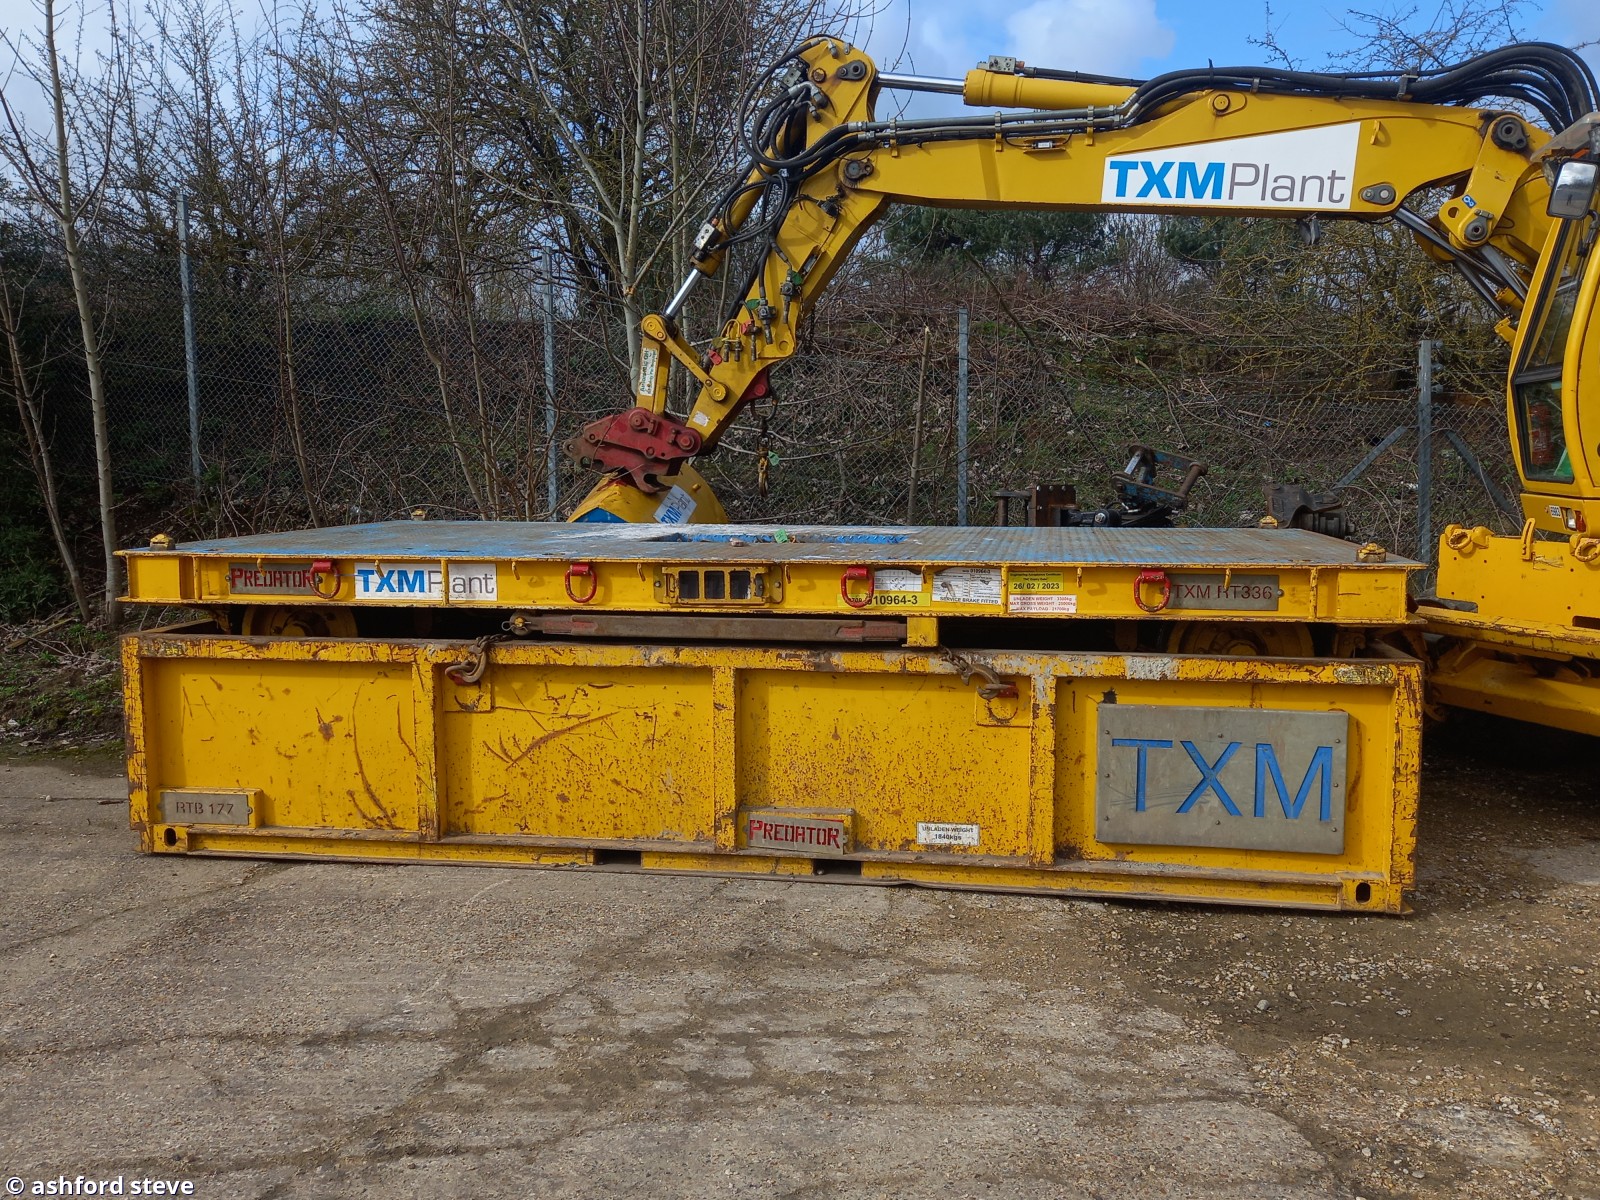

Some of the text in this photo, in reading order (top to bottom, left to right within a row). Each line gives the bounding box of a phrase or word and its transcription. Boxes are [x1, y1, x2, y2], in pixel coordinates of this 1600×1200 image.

[1109, 160, 1346, 204] TXMPlant
[231, 568, 312, 589] PREDATOR
[357, 569, 495, 595] TXMPant
[1172, 584, 1273, 600] TXM RT336
[1111, 738, 1333, 822] TXM
[175, 801, 234, 815] RTB 177
[749, 819, 841, 849] PREDATOR
